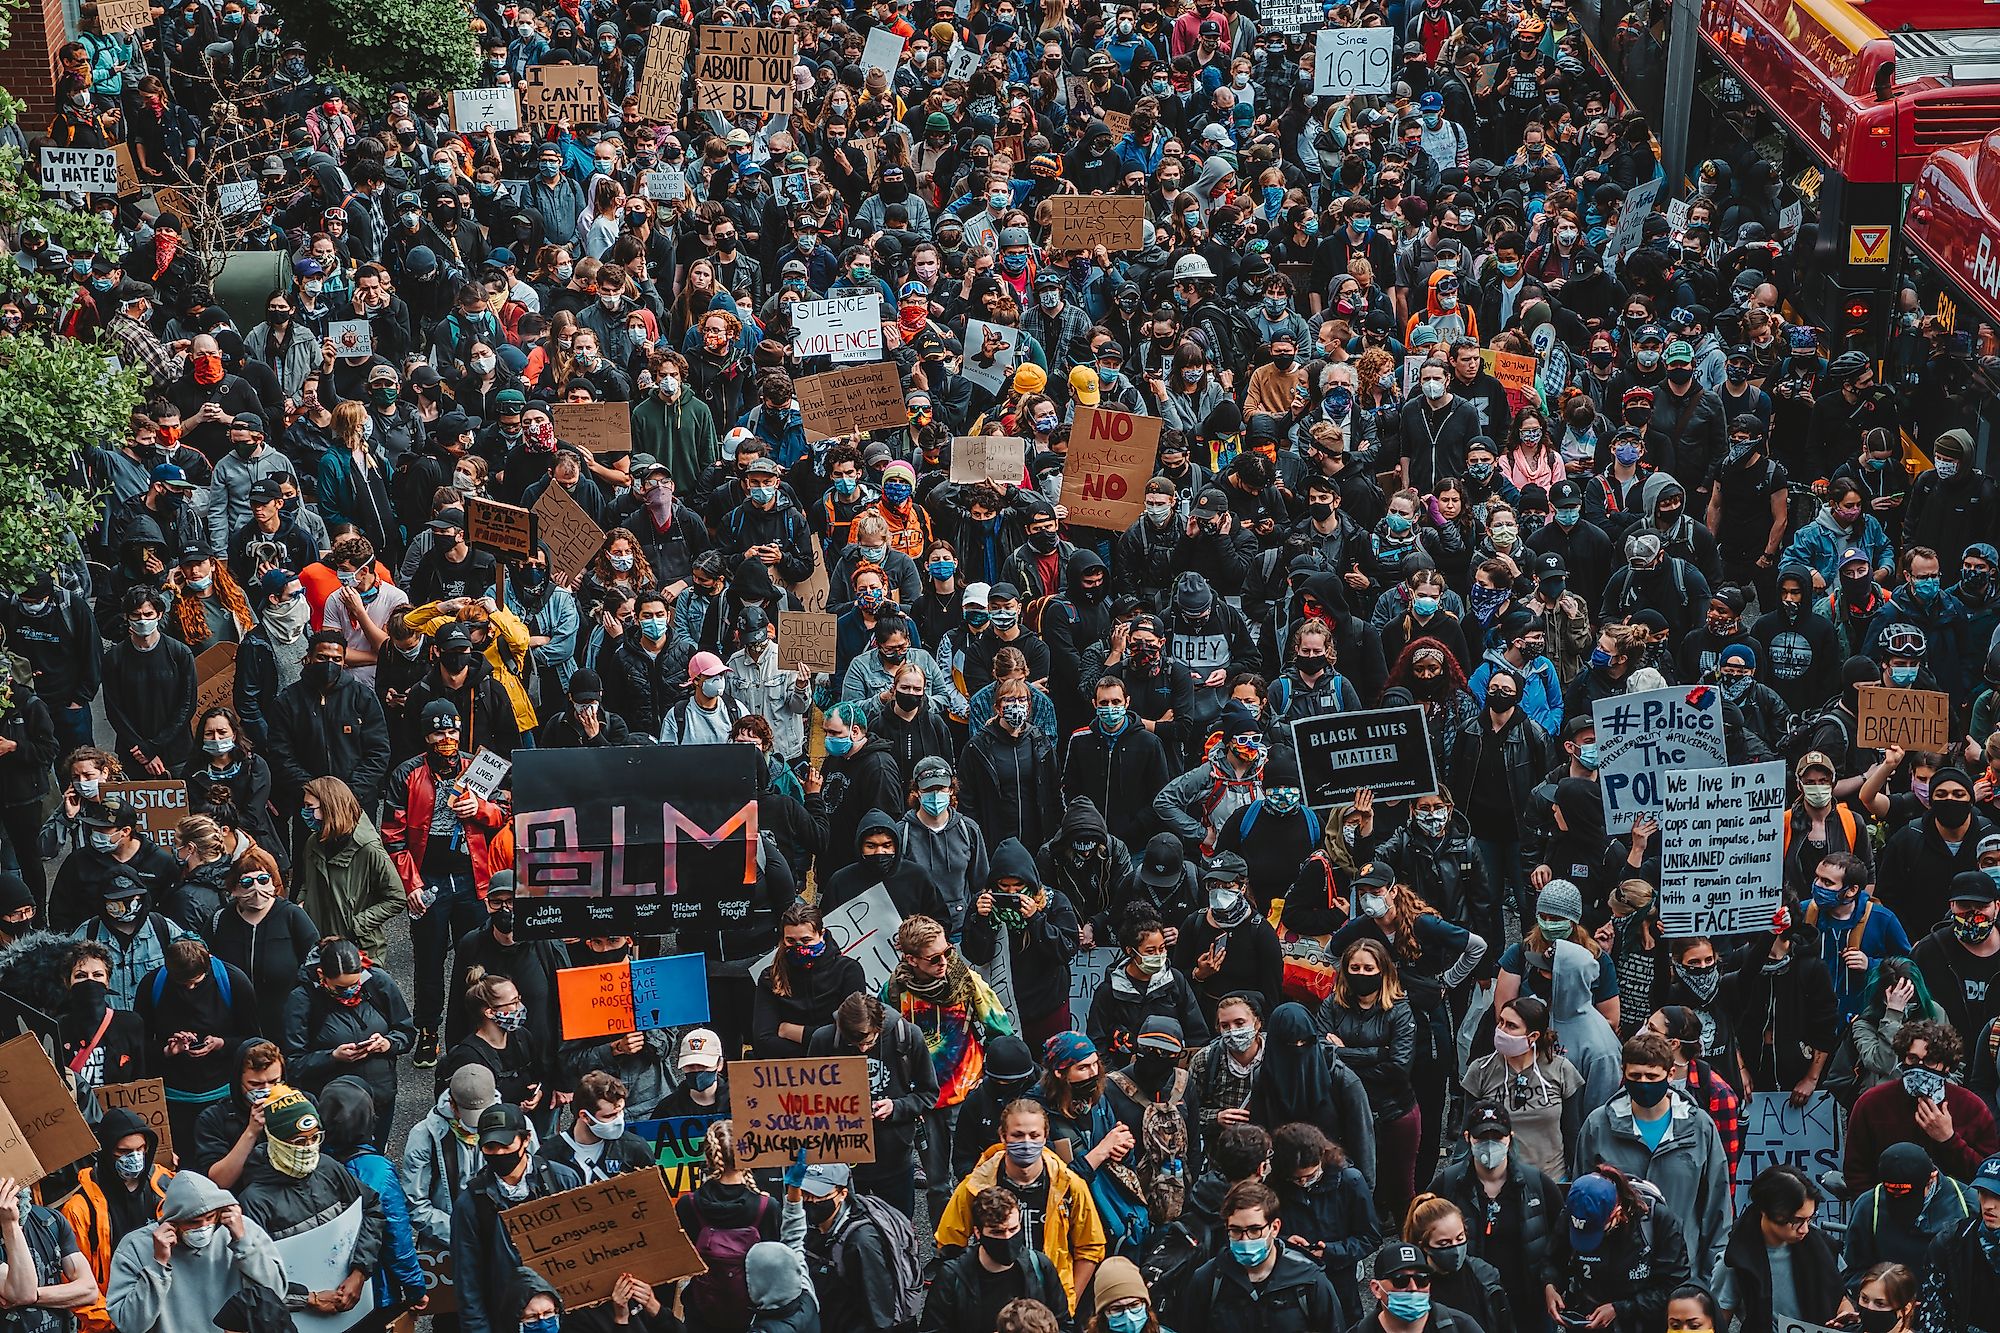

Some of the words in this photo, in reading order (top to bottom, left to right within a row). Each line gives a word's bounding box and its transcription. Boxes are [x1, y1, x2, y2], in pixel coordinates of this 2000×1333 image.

[104, 1, 144, 17] LIVES
[1261, 6, 1297, 17] oppressed
[1273, 16, 1293, 25] react
[1295, 15, 1304, 23] to
[1306, 12, 1323, 22] their
[101, 12, 151, 30] MATTER
[648, 25, 689, 57] BLACK
[757, 30, 793, 56] NOT
[1337, 32, 1368, 46] Since
[1804, 30, 1826, 57] HYBRID
[645, 48, 685, 76] LIVES
[700, 56, 754, 81] ABOUT
[757, 57, 793, 85] YOU
[1323, 46, 1390, 88] 1619
[529, 67, 544, 86] I
[652, 71, 669, 80] ARE
[461, 90, 508, 102] MIGHT
[541, 80, 593, 102] CAN'T
[640, 76, 680, 103] HUMAN
[733, 84, 786, 112] BLM
[529, 103, 598, 122] BREATHE
[638, 94, 677, 120] LIVES
[465, 119, 510, 132] RIGHT
[46, 150, 89, 165] WHY
[94, 152, 115, 167] DO
[42, 168, 55, 182] U
[58, 167, 98, 183] HATE
[100, 167, 118, 184] US
[649, 191, 684, 199] MATTER
[1062, 200, 1122, 216] BLACK
[801, 214, 818, 228] BLM
[1063, 216, 1107, 230] LIVES
[1062, 231, 1133, 246] MATTER
[1864, 256, 1884, 264] Buses
[796, 296, 869, 320] SILENCE
[1936, 291, 1957, 336] 6241
[341, 323, 357, 333] NO
[345, 345, 371, 354] PEACE
[795, 328, 879, 355] VIOLENCE
[842, 351, 867, 359] MATTER
[805, 378, 820, 394] I
[828, 371, 883, 389] understand
[801, 398, 825, 411] that
[830, 393, 843, 405] I
[846, 389, 862, 400] will
[866, 385, 895, 396] never
[807, 402, 867, 421] understand
[870, 397, 902, 409] however
[833, 416, 849, 431] I
[1089, 410, 1134, 442] NO
[967, 459, 1014, 473] POLICE
[1081, 473, 1128, 502] NO
[538, 490, 565, 535] LACK
[1068, 505, 1112, 520] peace
[553, 521, 601, 574] MATTER
[781, 619, 836, 637] SILENCE
[797, 636, 814, 648] IS
[1173, 640, 1221, 661] OBEY
[780, 647, 835, 665] VIOLENCE
[1887, 693, 1944, 715] CAN'T
[1601, 700, 1715, 735] #Police
[1310, 727, 1358, 747] BLACK
[1367, 722, 1408, 739] LIVES
[1600, 735, 1624, 752] #END
[1695, 729, 1721, 745] #END
[481, 753, 504, 772] BLACK
[1337, 747, 1393, 766] MATTER
[1634, 740, 1686, 767] The
[475, 767, 494, 783] LIVES
[1666, 775, 1687, 793] We
[1697, 774, 1723, 792] live
[1731, 772, 1746, 789] in
[1754, 773, 1765, 784] a
[461, 776, 488, 796] MATTER
[1665, 795, 1700, 812] World
[1706, 794, 1743, 809] where
[1744, 788, 1785, 807] TRAINED
[1664, 818, 1689, 835] cops
[1692, 820, 1711, 830] can
[1716, 816, 1745, 833] panic
[1749, 810, 1772, 825] and
[1664, 837, 1684, 848] act
[1688, 837, 1702, 848] on
[1708, 833, 1755, 849] impulse,
[1757, 828, 1778, 842] but
[514, 801, 759, 898] BLM
[1663, 850, 1725, 869] UNTRAINED
[1728, 852, 1772, 865] civilians
[1662, 876, 1688, 887] must
[1694, 875, 1731, 887] remain
[1735, 872, 1762, 884] calm
[671, 901, 702, 912] Michael
[717, 899, 751, 910] George
[1662, 890, 1685, 905] with
[1692, 893, 1700, 903] a
[1704, 891, 1731, 909] gun
[1739, 888, 1754, 900] in
[1757, 885, 1783, 899] their
[536, 905, 562, 917] John
[720, 906, 747, 920] Floyd
[1694, 907, 1739, 932] FACE
[525, 916, 563, 927] Crawford
[600, 972, 613, 982] NO
[618, 965, 656, 980] JUSTICE
[600, 983, 614, 993] NO
[620, 978, 657, 993] PEACE
[591, 990, 660, 1008] PROSECUTE
[753, 1063, 842, 1088] SILENCE
[105, 1084, 160, 1110] LIVES
[746, 1096, 758, 1109] is
[778, 1092, 860, 1116] VIOLENCE
[765, 1113, 830, 1131] SCREAM
[834, 1114, 865, 1132] that
[508, 1218, 519, 1234] A
[570, 1196, 593, 1213] IS
[597, 1184, 637, 1205] The
[526, 1219, 619, 1254] Language
[540, 1256, 577, 1277] The
[582, 1231, 648, 1266] Unheard
[556, 1279, 593, 1297] MLK
